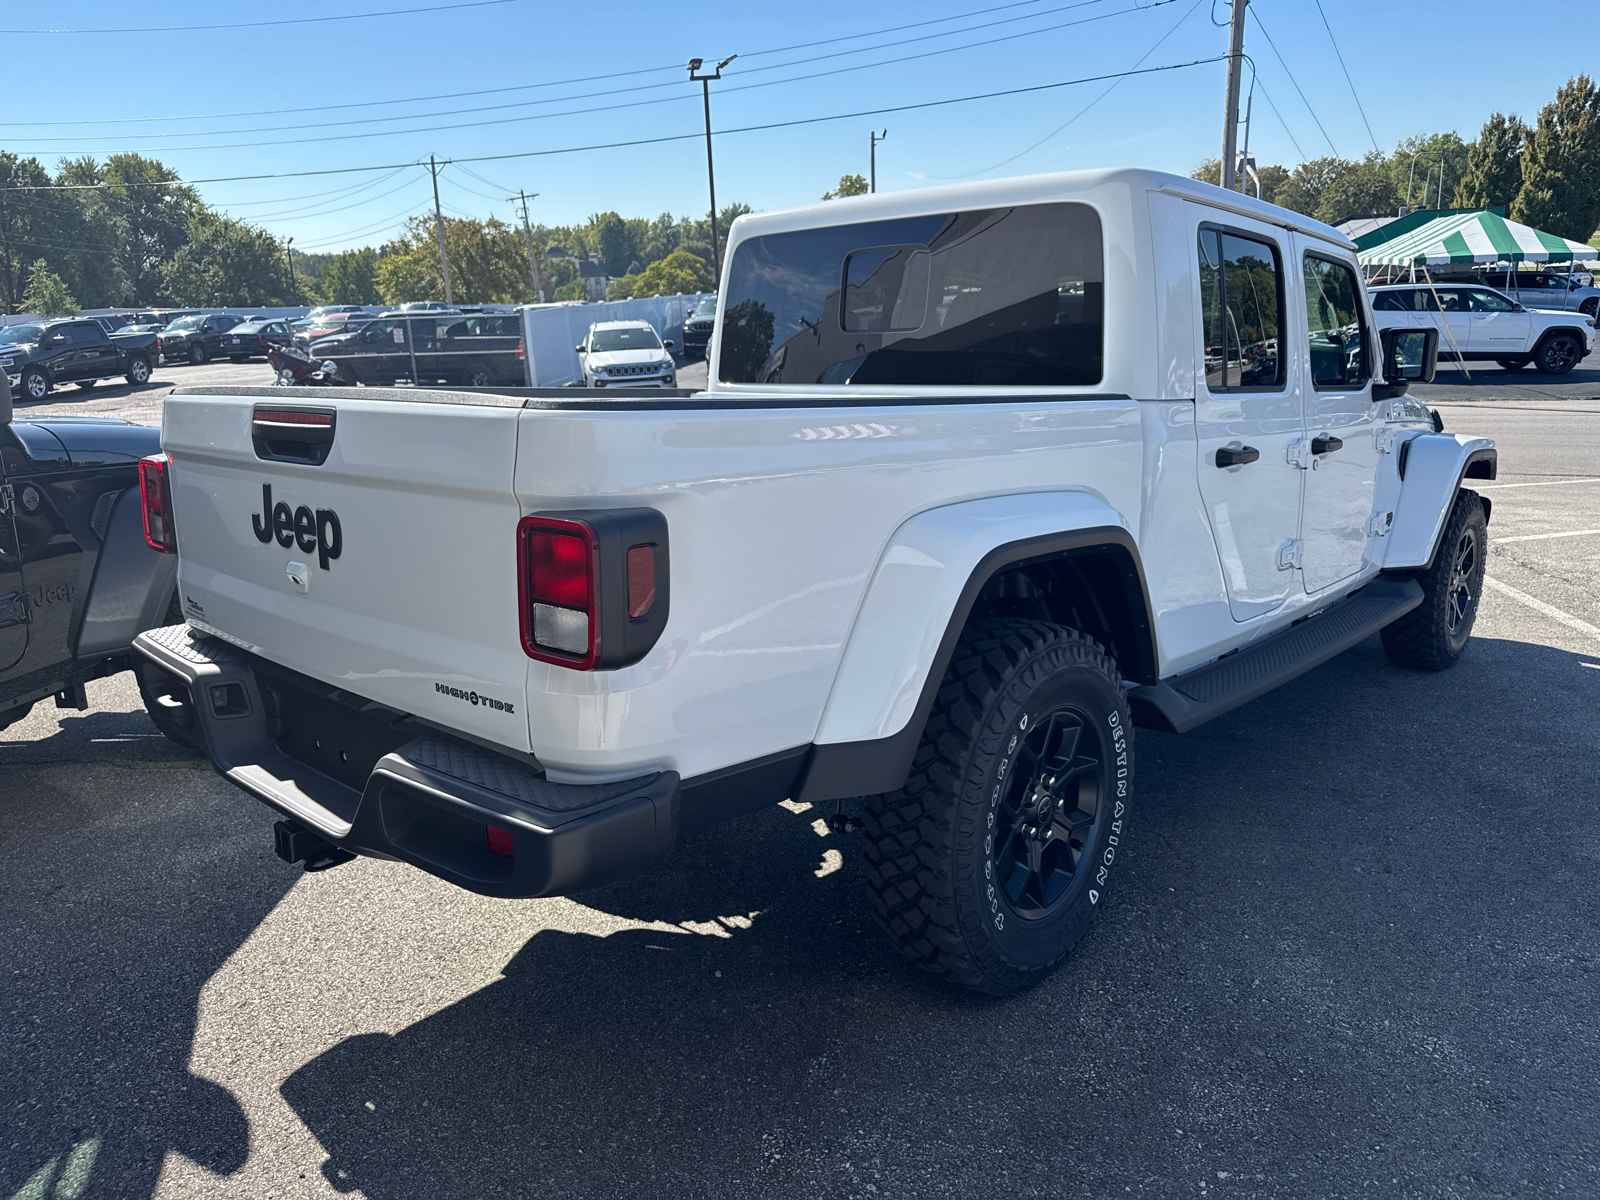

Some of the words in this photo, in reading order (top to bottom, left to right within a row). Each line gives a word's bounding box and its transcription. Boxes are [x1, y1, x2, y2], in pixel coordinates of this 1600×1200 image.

[252, 482, 343, 571] Jeep
[435, 682, 469, 701] HIGH
[479, 695, 514, 714] TIDE
[984, 734, 1017, 931] FIRESTONE
[1096, 710, 1127, 886] DESTINATION
